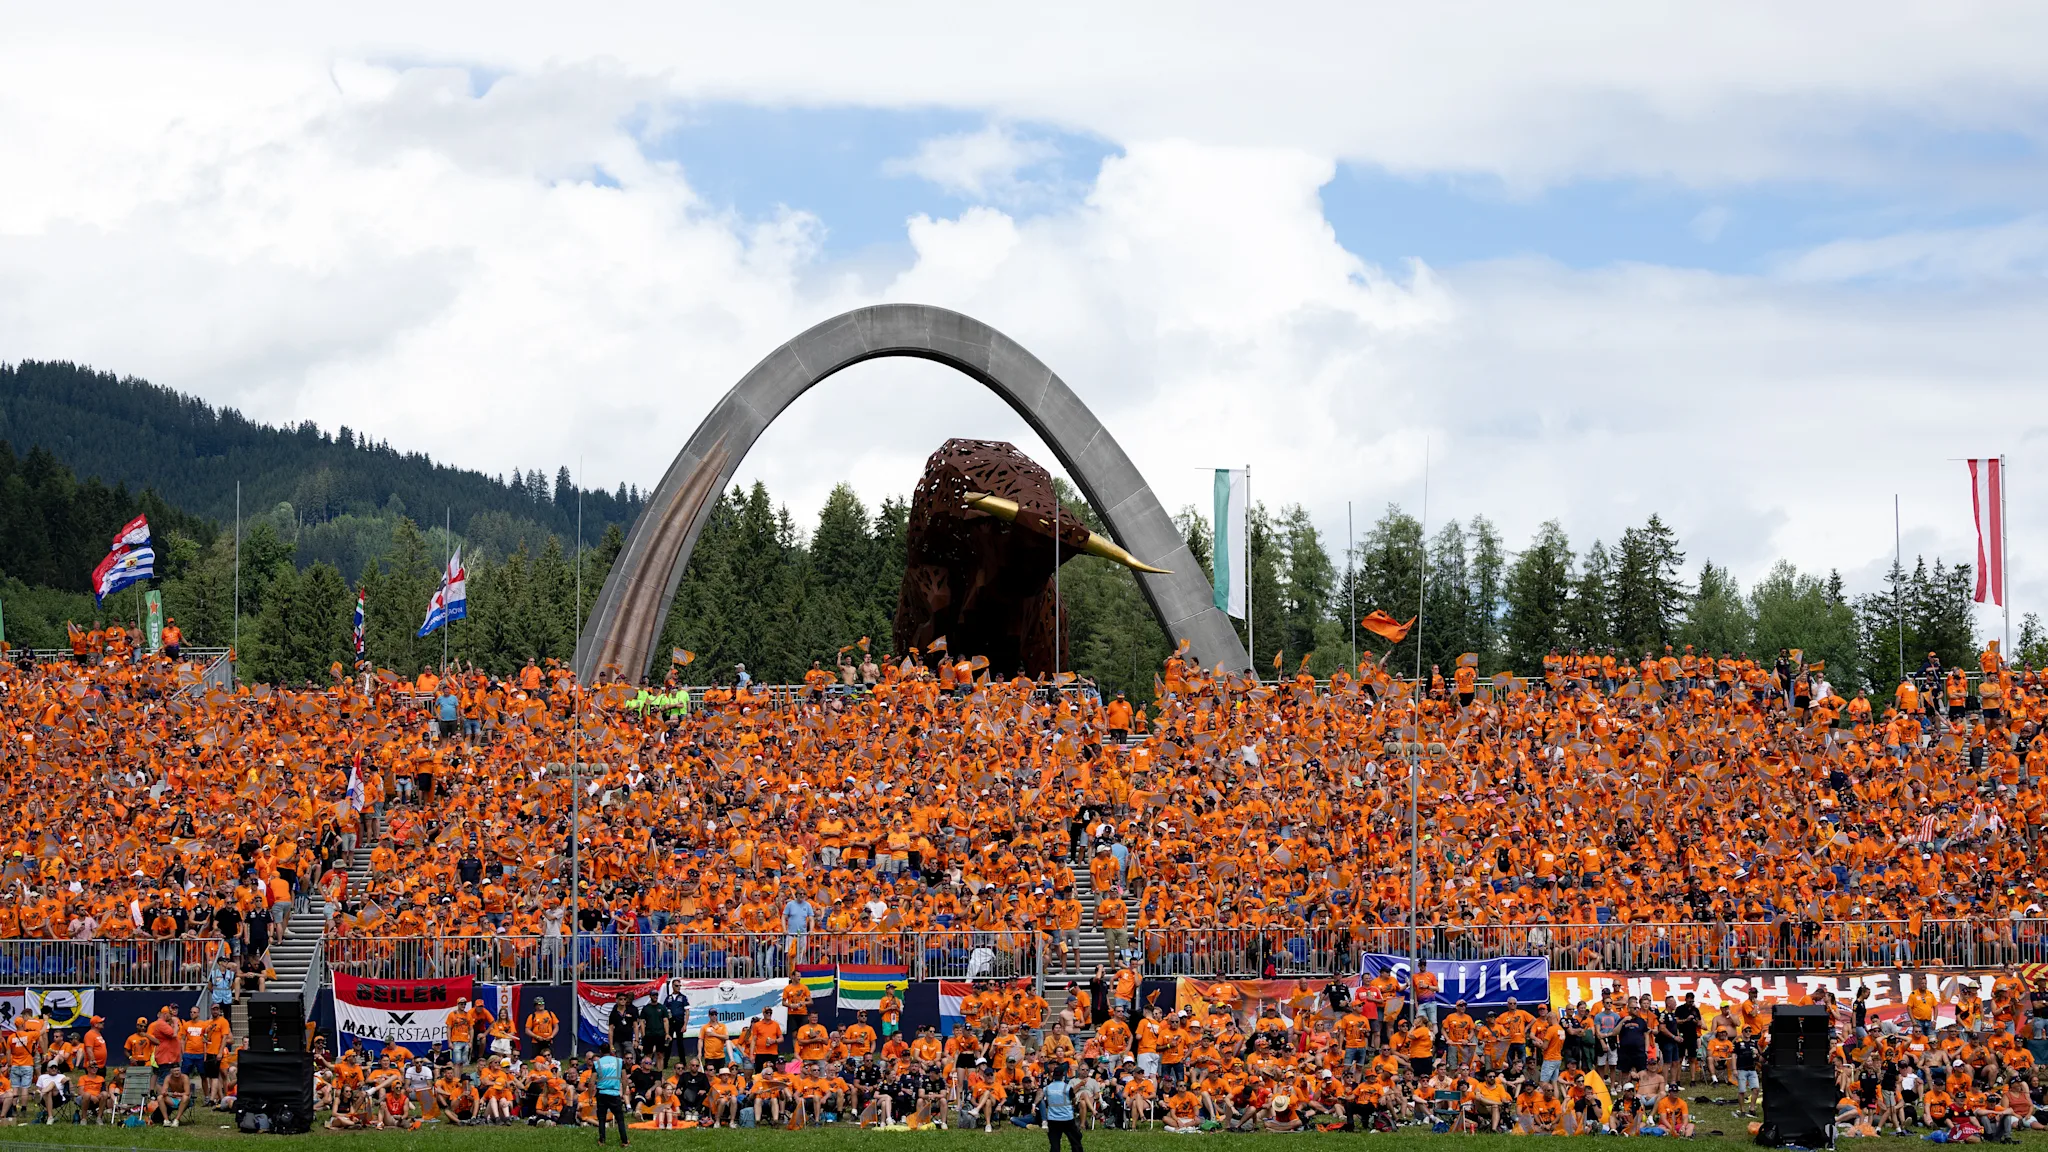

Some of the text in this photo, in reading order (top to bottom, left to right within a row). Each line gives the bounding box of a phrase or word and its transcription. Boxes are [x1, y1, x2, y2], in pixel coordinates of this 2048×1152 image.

[357, 983, 447, 1003] BEILEN
[1797, 973, 1891, 1009] THE
[719, 1011, 745, 1021] nhem
